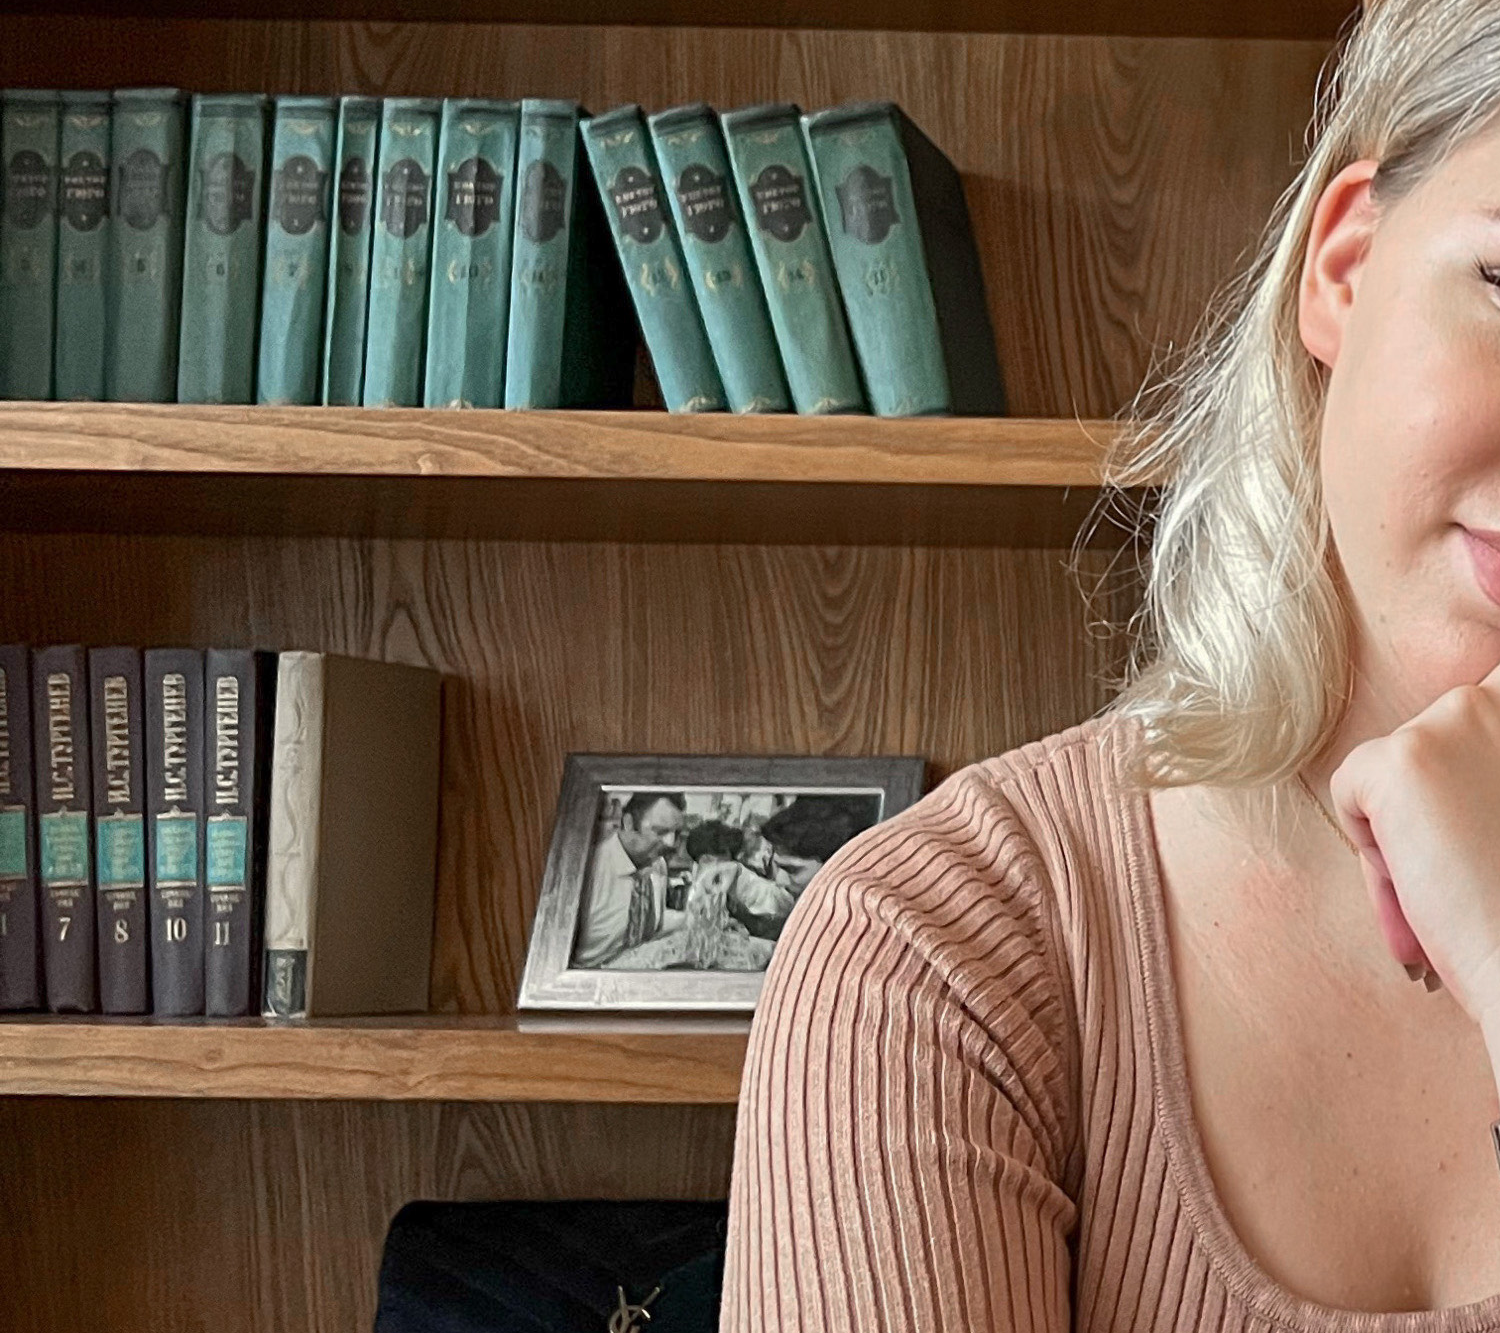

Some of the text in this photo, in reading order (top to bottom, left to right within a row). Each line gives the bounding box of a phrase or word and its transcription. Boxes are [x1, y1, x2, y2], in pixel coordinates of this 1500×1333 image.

[60, 916, 71, 941] 7
[114, 919, 129, 943] 8
[167, 918, 187, 941] 10
[214, 921, 230, 946] 11
